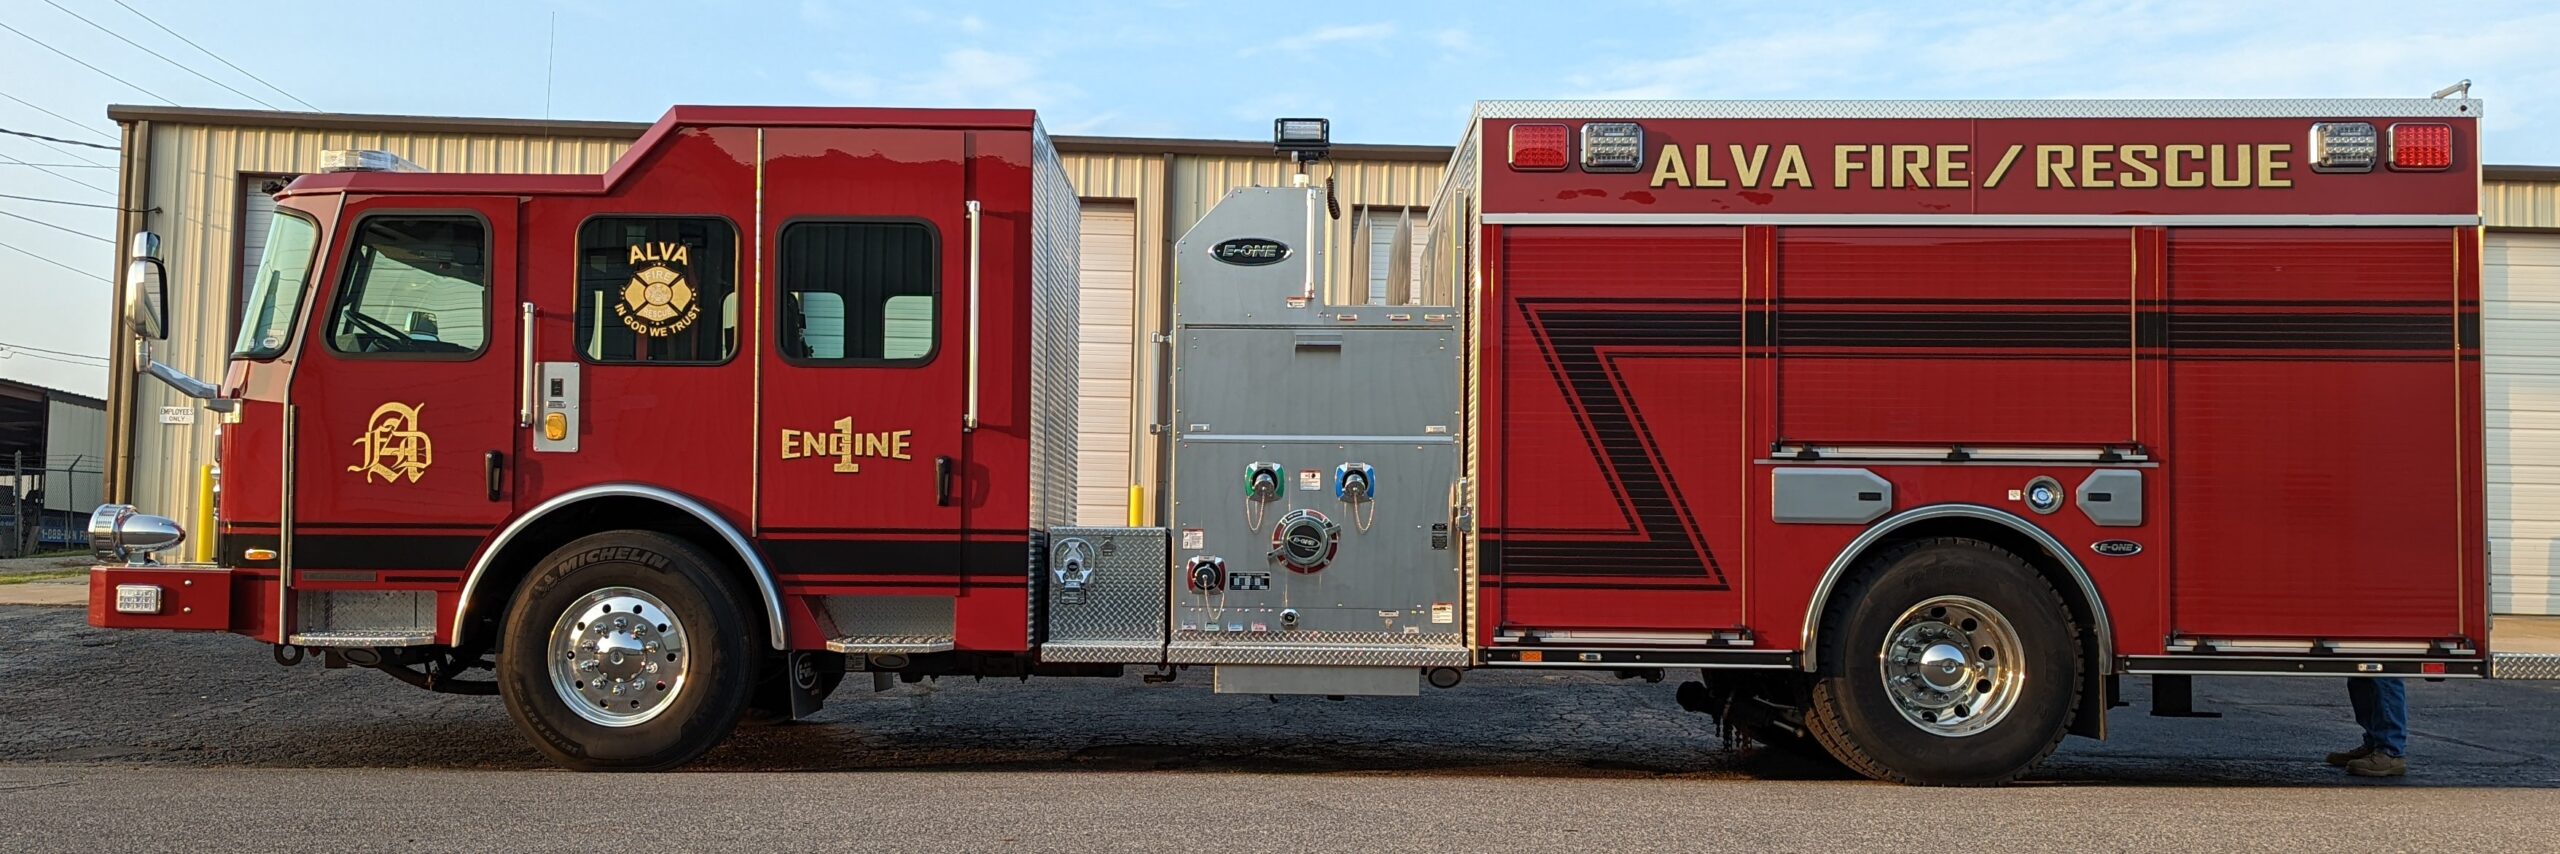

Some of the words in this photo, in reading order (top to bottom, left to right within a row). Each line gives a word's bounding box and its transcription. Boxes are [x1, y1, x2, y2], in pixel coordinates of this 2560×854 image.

[1649, 143, 1813, 188] ALVA
[1834, 144, 1970, 188] FIRE
[2036, 143, 2293, 188] RESCUE
[629, 241, 689, 266] ALVA
[1222, 244, 1278, 258] E-ONE
[645, 271, 672, 282] FIRE
[614, 303, 627, 317] IN
[623, 315, 648, 334] GOD
[649, 327, 669, 337] WE
[668, 303, 701, 334] TRUST
[781, 428, 912, 461] ENGINE
[558, 546, 671, 577] MICHELIN
[2100, 543, 2134, 552] E-ONE
